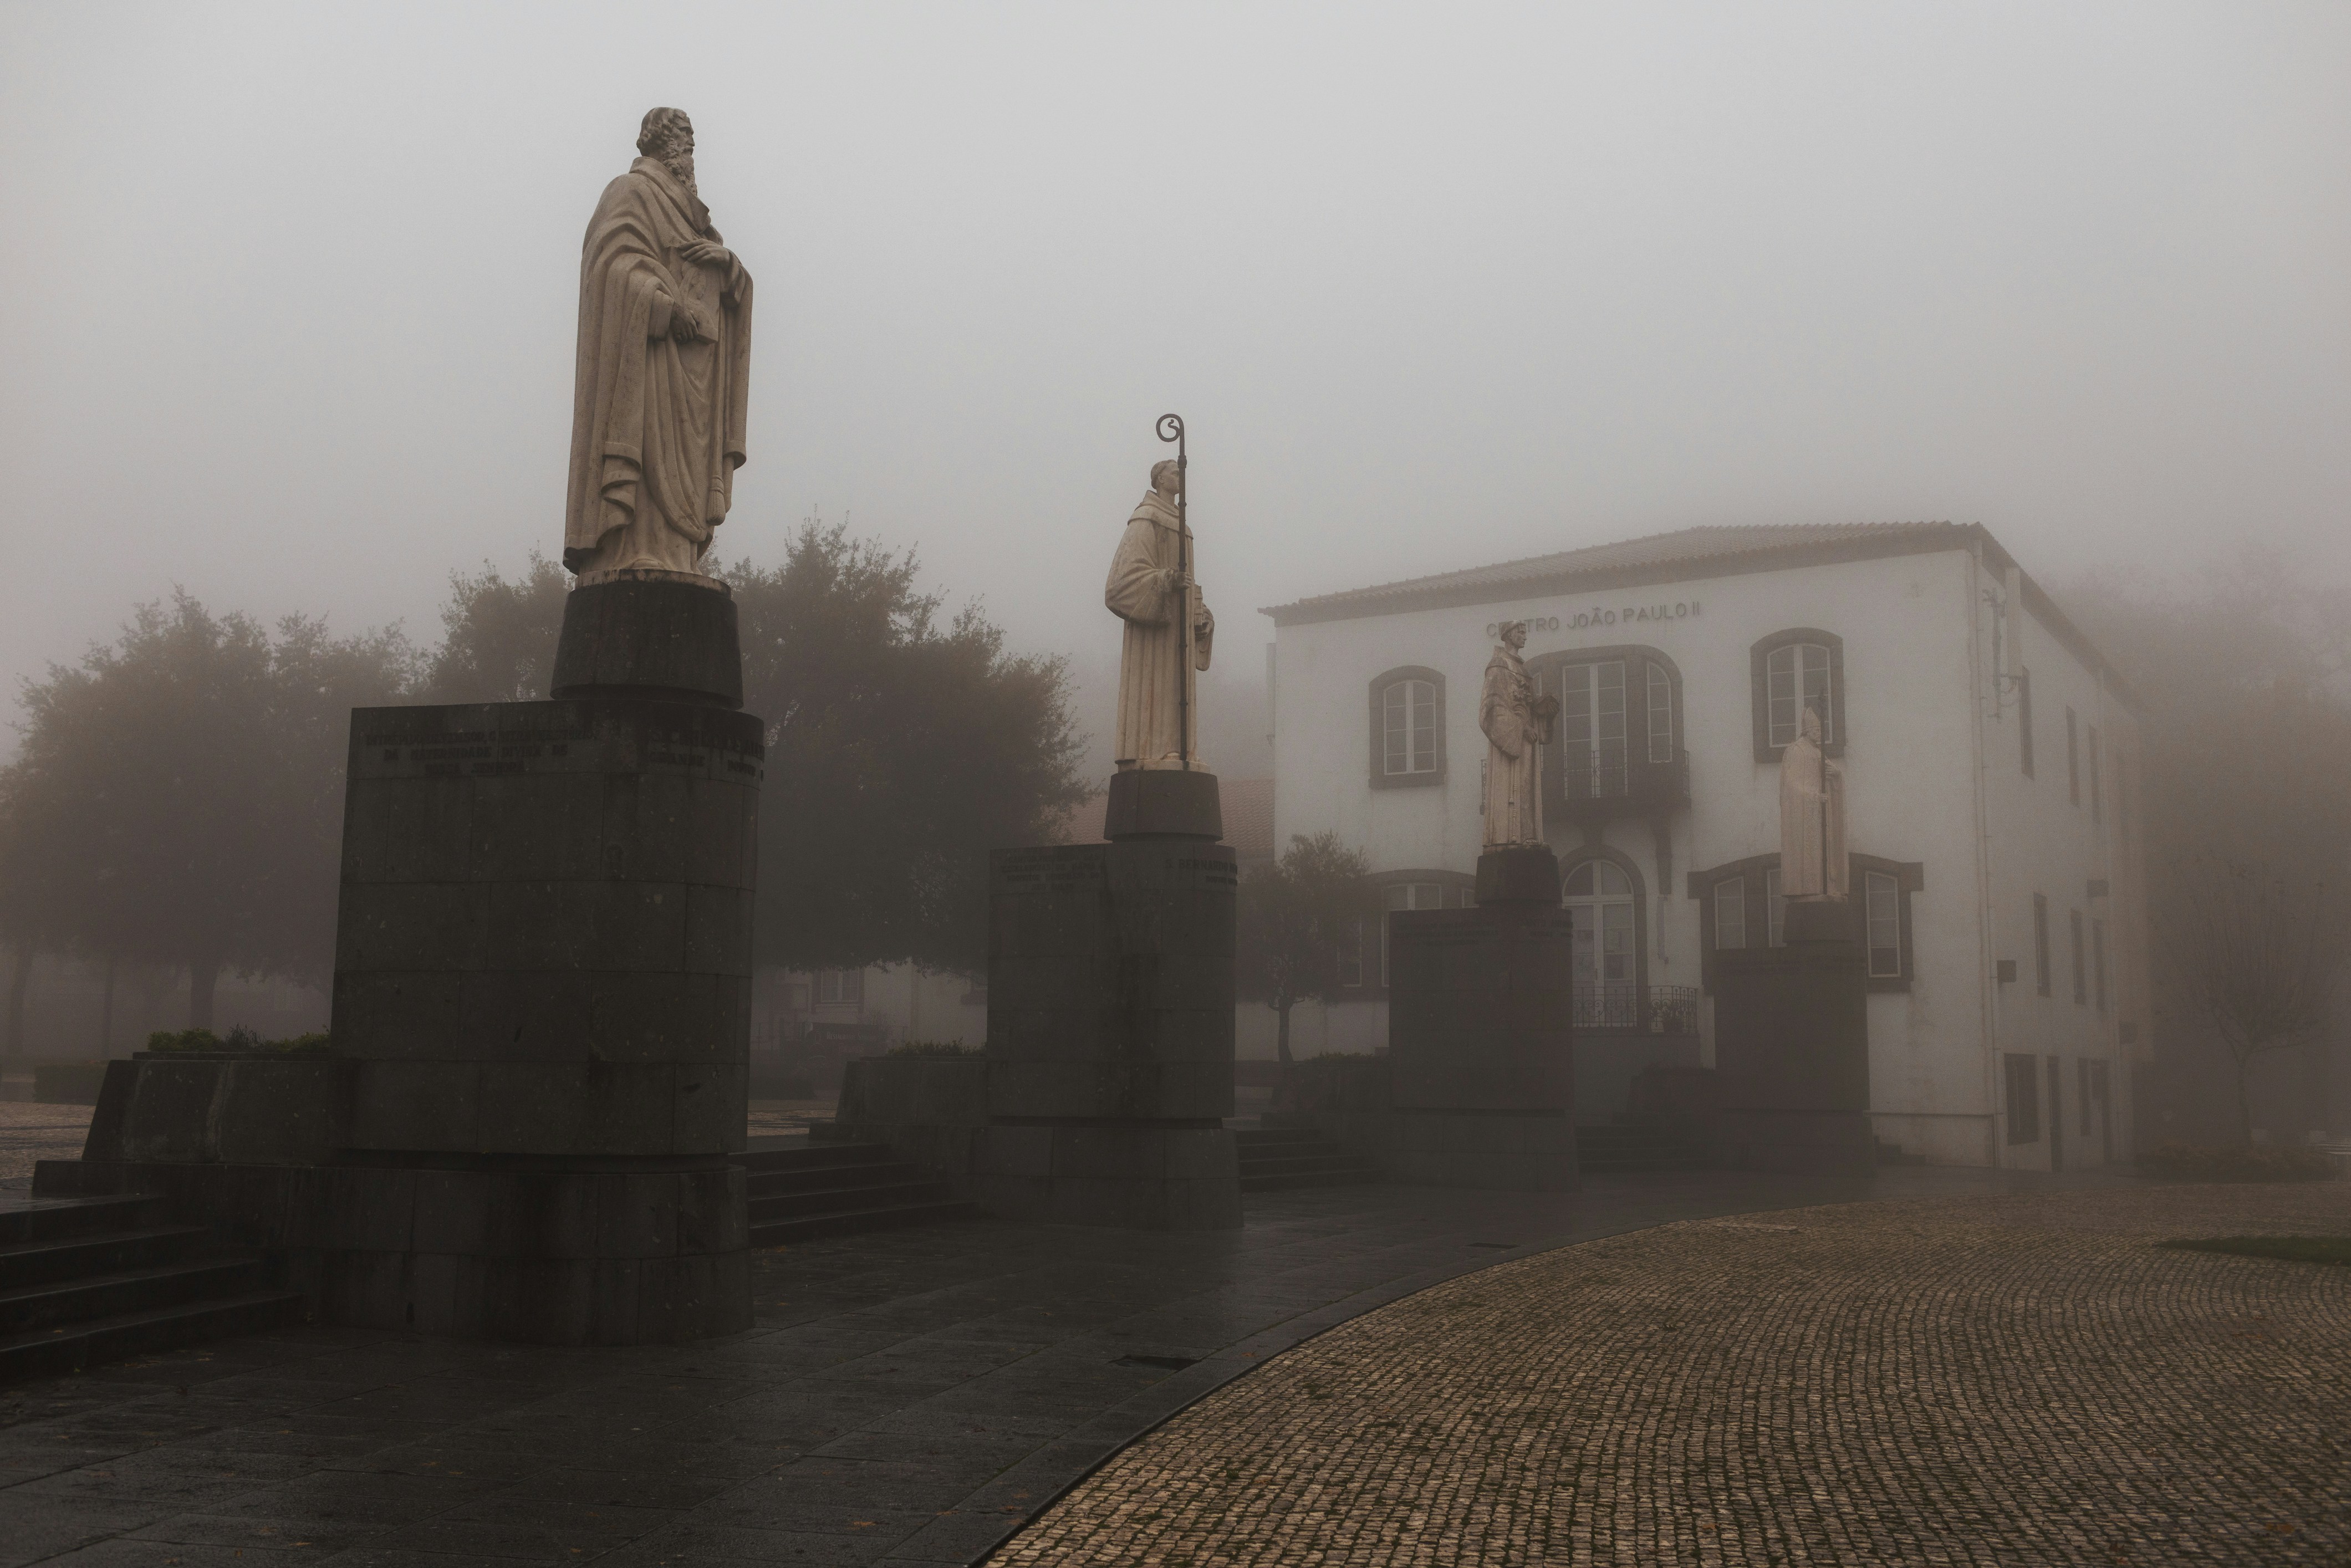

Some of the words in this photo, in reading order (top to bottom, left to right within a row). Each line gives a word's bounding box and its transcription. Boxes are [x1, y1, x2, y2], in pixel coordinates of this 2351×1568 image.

[1486, 616, 1559, 637] CETRO
[1567, 607, 1615, 629] JOÃO
[1623, 602, 1687, 623] PAULO
[1691, 601, 1701, 616] II
[1179, 859, 1228, 872] BERNARDO
